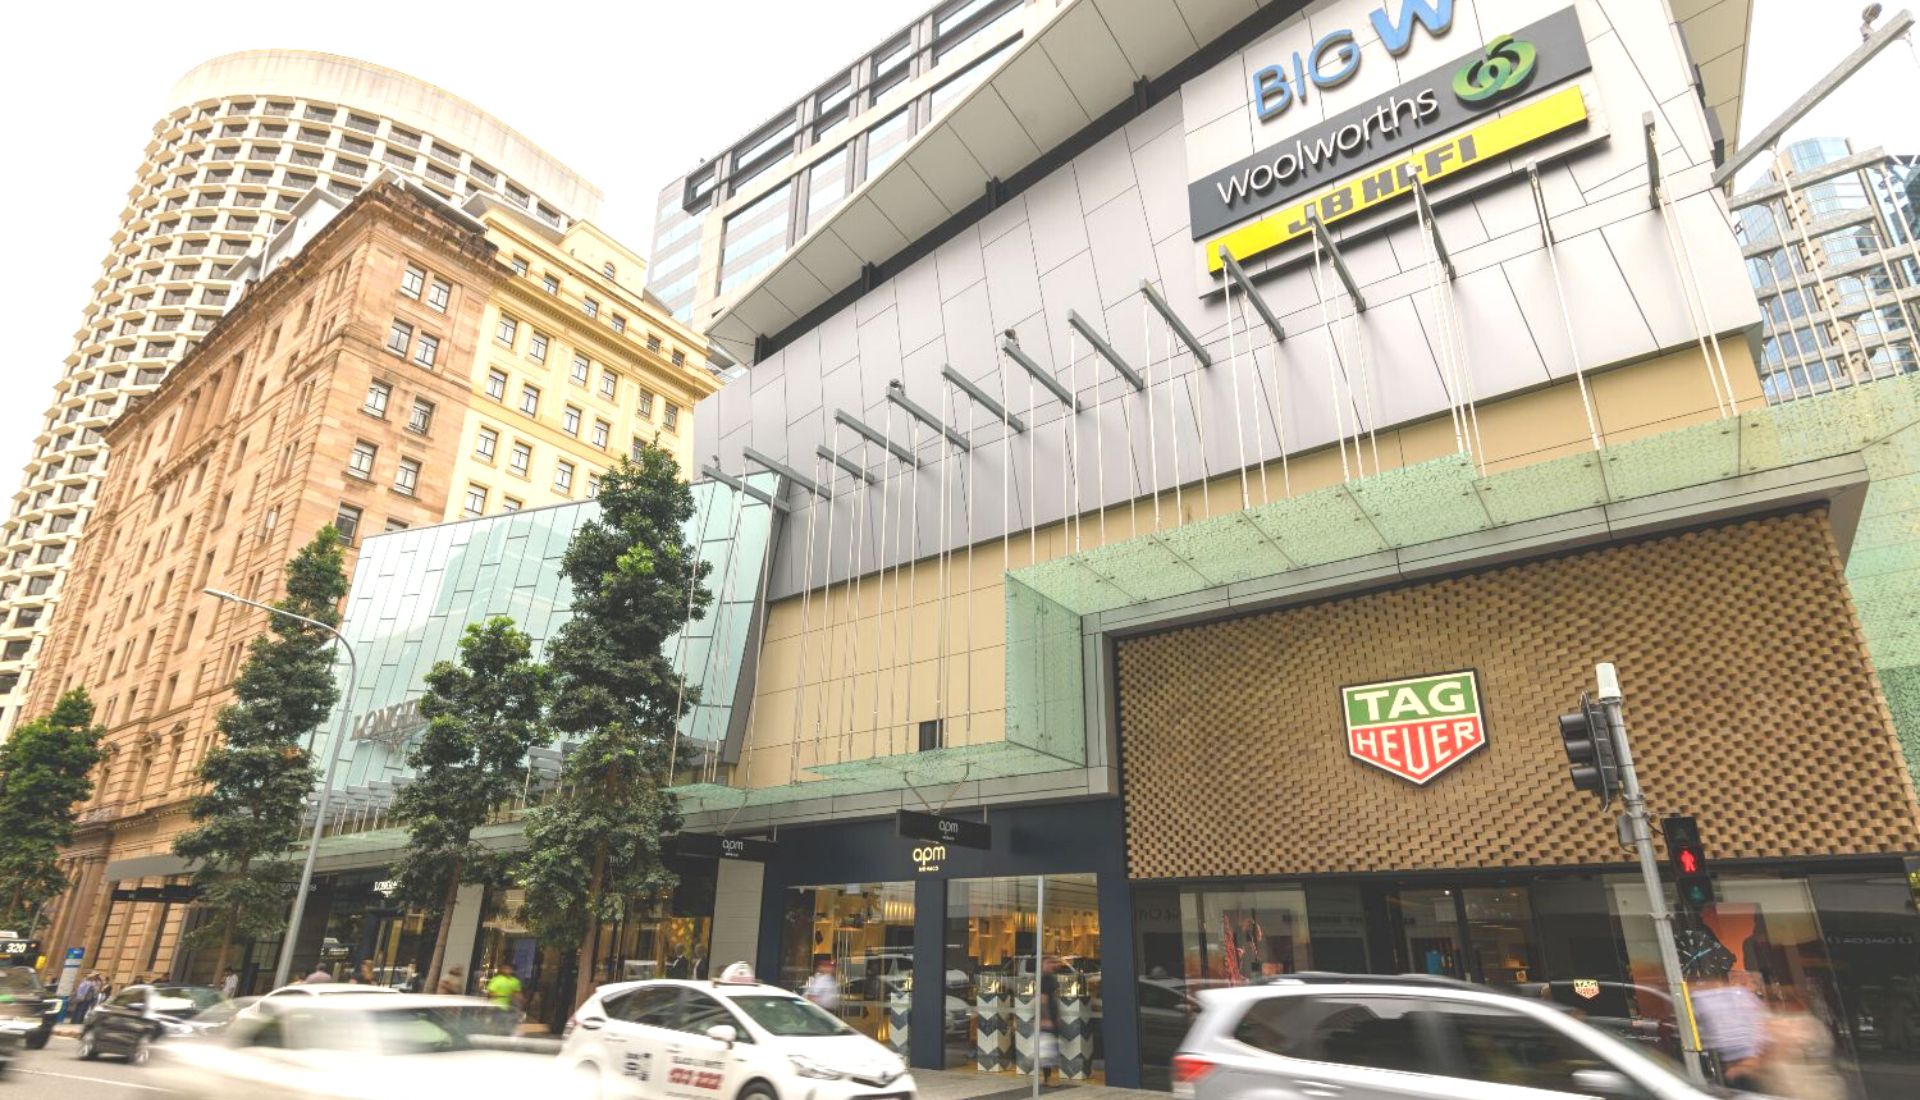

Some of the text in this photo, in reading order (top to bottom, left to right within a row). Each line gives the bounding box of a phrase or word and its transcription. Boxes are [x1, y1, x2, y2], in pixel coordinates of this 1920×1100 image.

[1252, 0, 1454, 122] BIG W
[1217, 87, 1438, 205] Woolworths
[1288, 187, 1354, 235] JB
[1354, 681, 1467, 721] TAG
[1356, 720, 1476, 775] HEUER
[939, 820, 959, 834] apm
[913, 846, 946, 866] apm
[6, 943, 27, 953] 320
